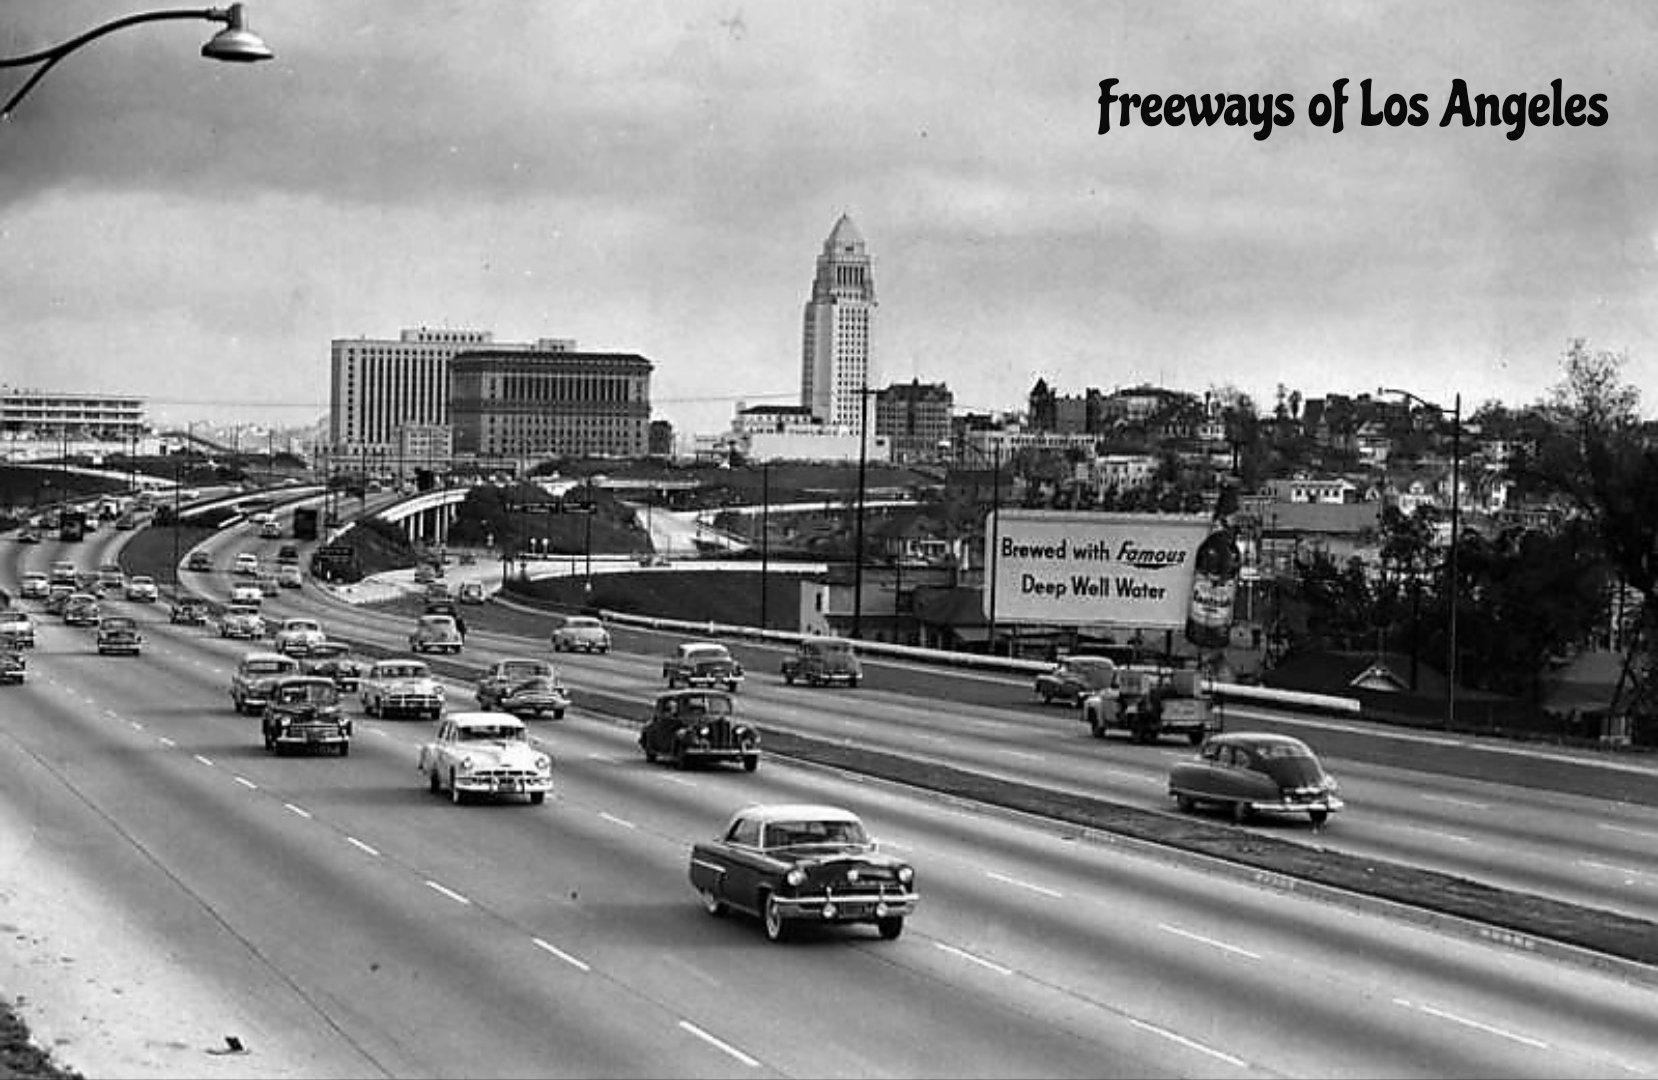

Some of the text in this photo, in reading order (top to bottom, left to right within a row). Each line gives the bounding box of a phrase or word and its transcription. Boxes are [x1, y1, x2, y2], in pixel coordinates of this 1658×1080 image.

[1001, 536, 1187, 566] Brewed with Famous
[1021, 573, 1068, 600] Deep
[1071, 575, 1110, 598] Well
[1115, 577, 1166, 600] Water
